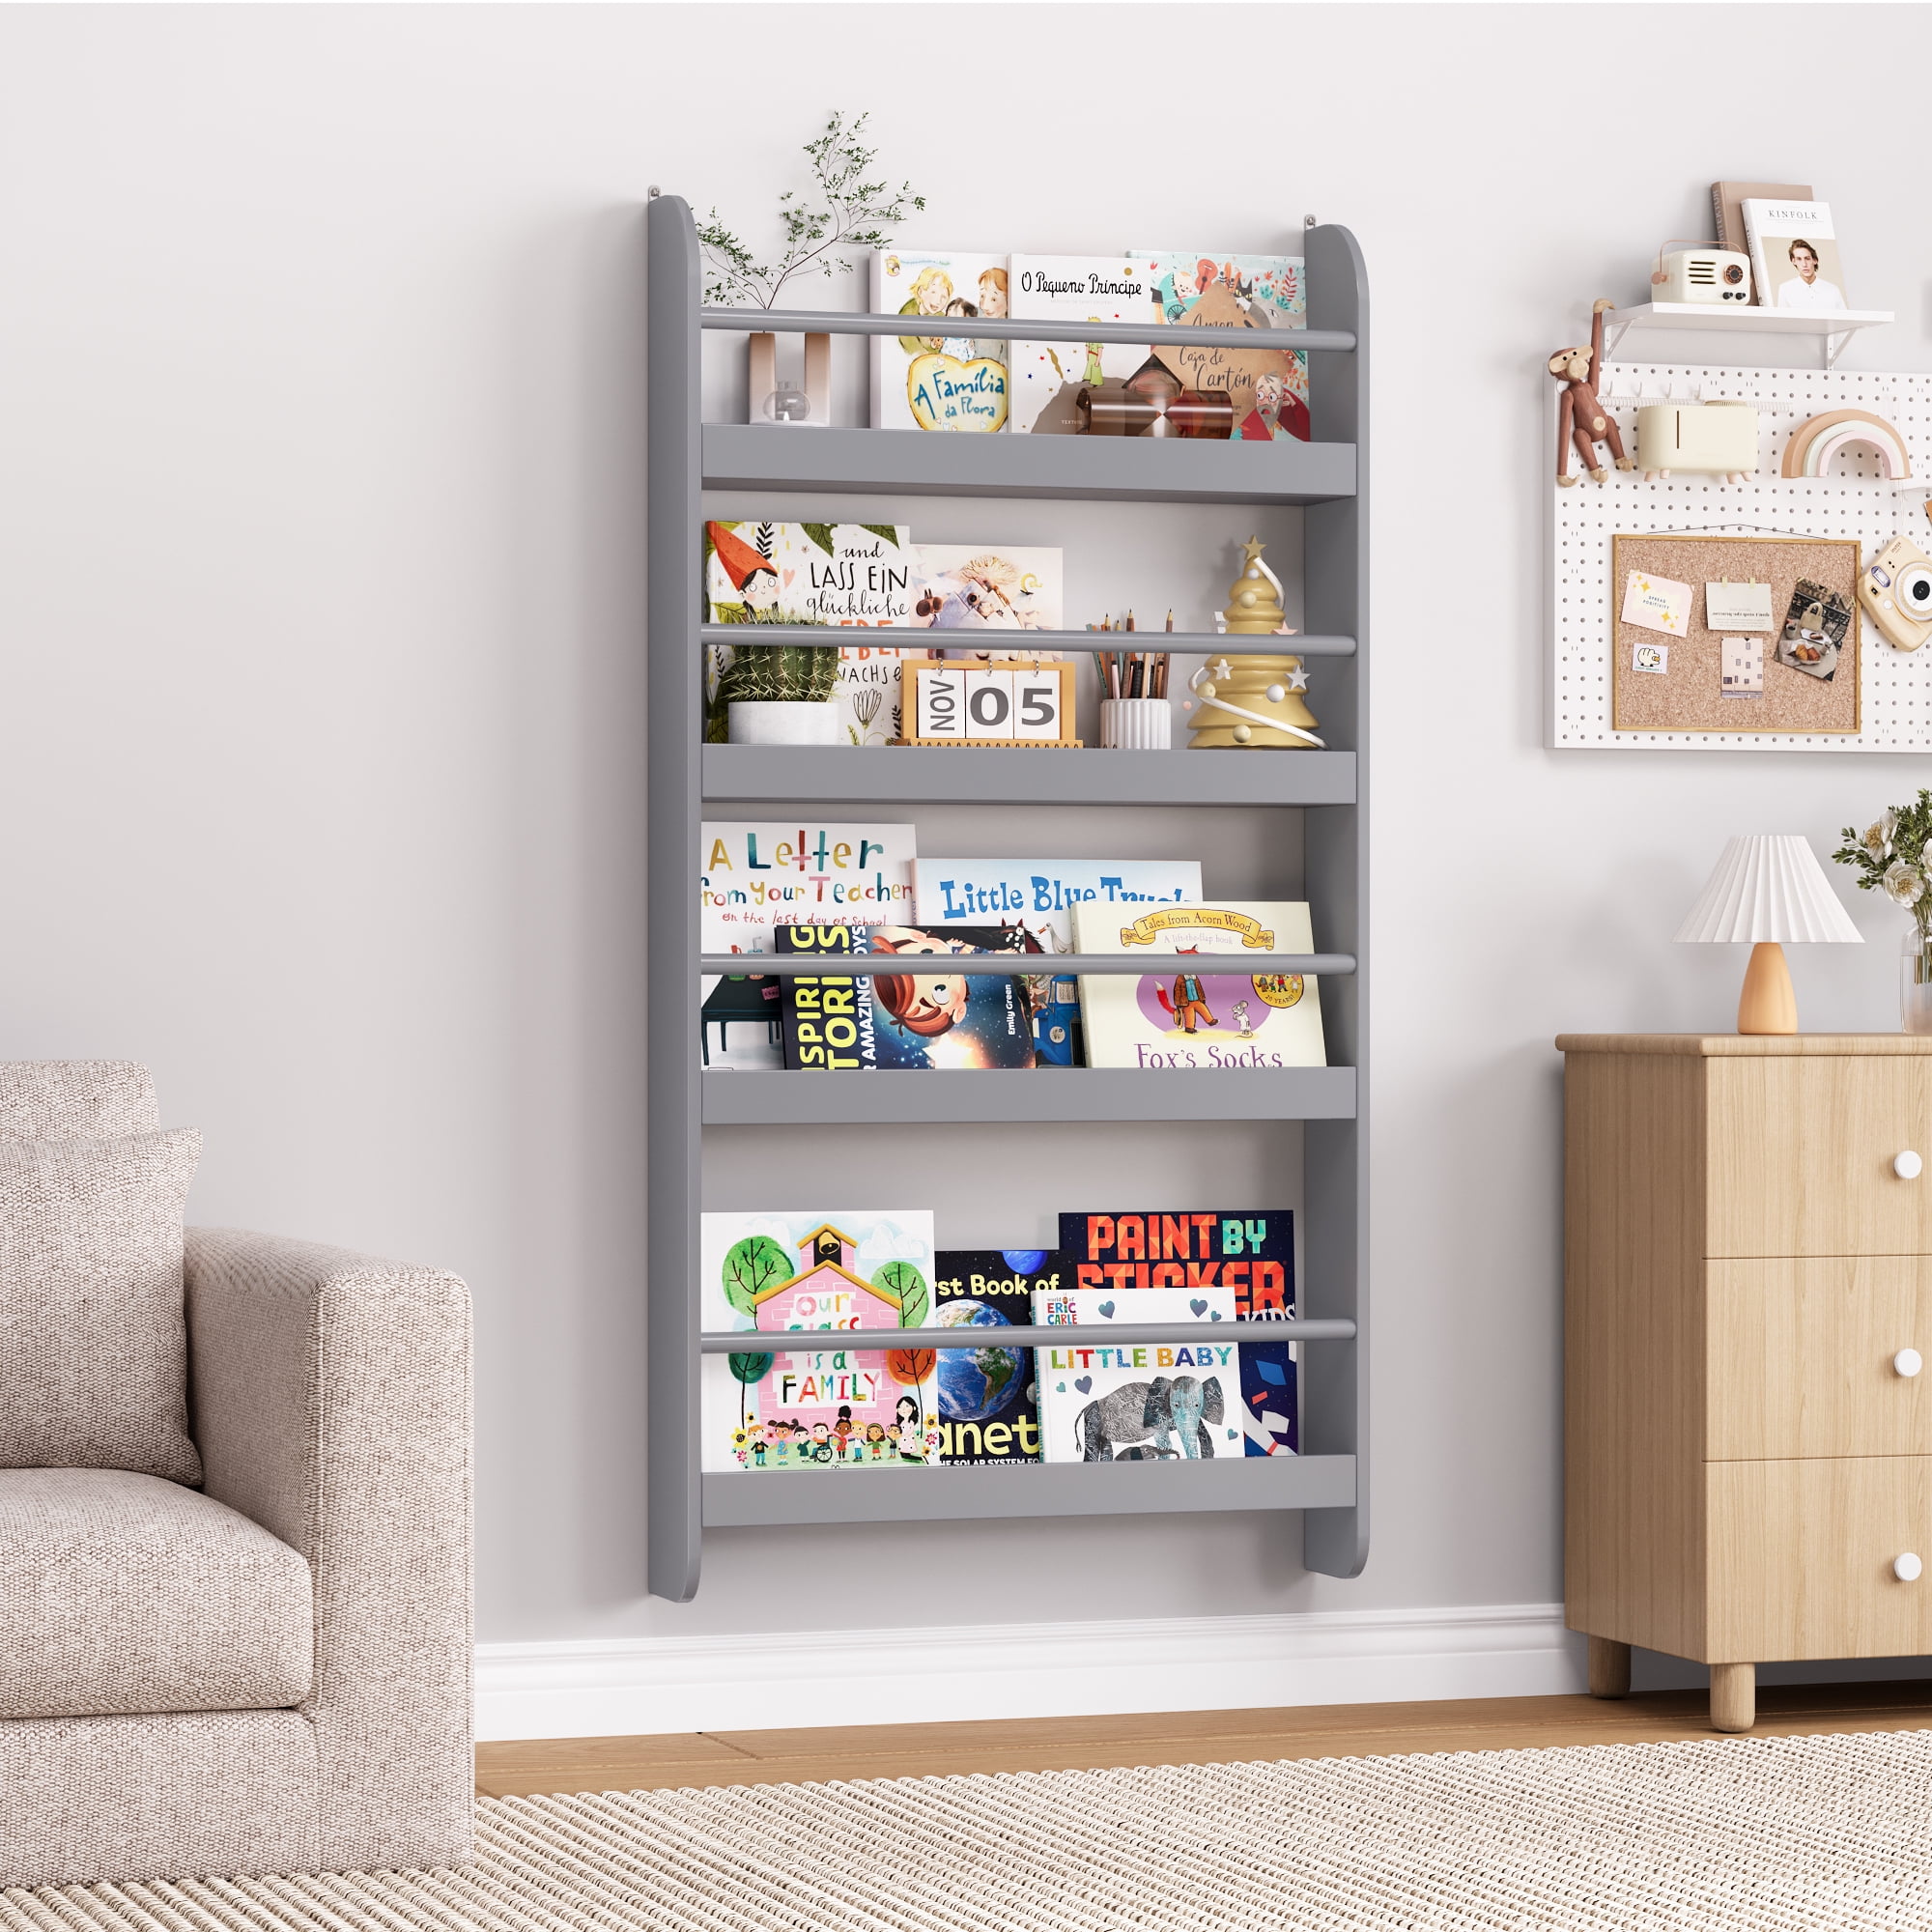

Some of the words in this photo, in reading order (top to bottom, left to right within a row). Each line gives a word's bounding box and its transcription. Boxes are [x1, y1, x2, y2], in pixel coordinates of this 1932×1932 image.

[1769, 210, 1817, 219] KINFOLK
[1021, 271, 1032, 292] O
[1035, 271, 1085, 297] Pequeno
[1088, 272, 1143, 298] Príncipe
[1179, 347, 1206, 371] Caja
[1209, 348, 1225, 365] de
[1196, 363, 1255, 392] Cartón
[913, 384, 936, 420] A
[932, 366, 1005, 398] Família
[945, 402, 957, 417] da
[960, 396, 996, 417] Flora
[839, 541, 885, 558] und
[810, 562, 855, 590] LASS
[807, 590, 910, 620] glückliche
[929, 679, 955, 731] NOV
[708, 838, 733, 871] A
[747, 830, 884, 872] Letter
[750, 881, 806, 906] your
[939, 880, 1024, 920] Little
[1030, 876, 1097, 912] Blue
[723, 913, 738, 922] on
[743, 912, 765, 923] the
[773, 910, 799, 924] last
[807, 913, 827, 925] day
[833, 917, 847, 925] of
[1140, 918, 1165, 930] Tales
[1167, 913, 1190, 924] from
[1194, 912, 1222, 924] Acorn
[1224, 914, 1252, 932] Wood
[1005, 984, 1013, 1009] Green
[856, 977, 876, 1061] AMAZING
[1007, 1010, 1015, 1036] Emily
[1133, 1043, 1197, 1068] Fox's
[1208, 1045, 1283, 1068] Socks
[1087, 1214, 1217, 1262] PAINT
[1222, 1219, 1266, 1255] BY
[970, 1273, 1029, 1296] Book
[1035, 1273, 1061, 1291] of
[1047, 1314, 1078, 1325] CARLE
[807, 1353, 824, 1370] is
[833, 1351, 847, 1370] a
[1051, 1348, 1148, 1370] LITTLE
[1157, 1346, 1234, 1368] BABY
[782, 1372, 880, 1404] FAMILY
